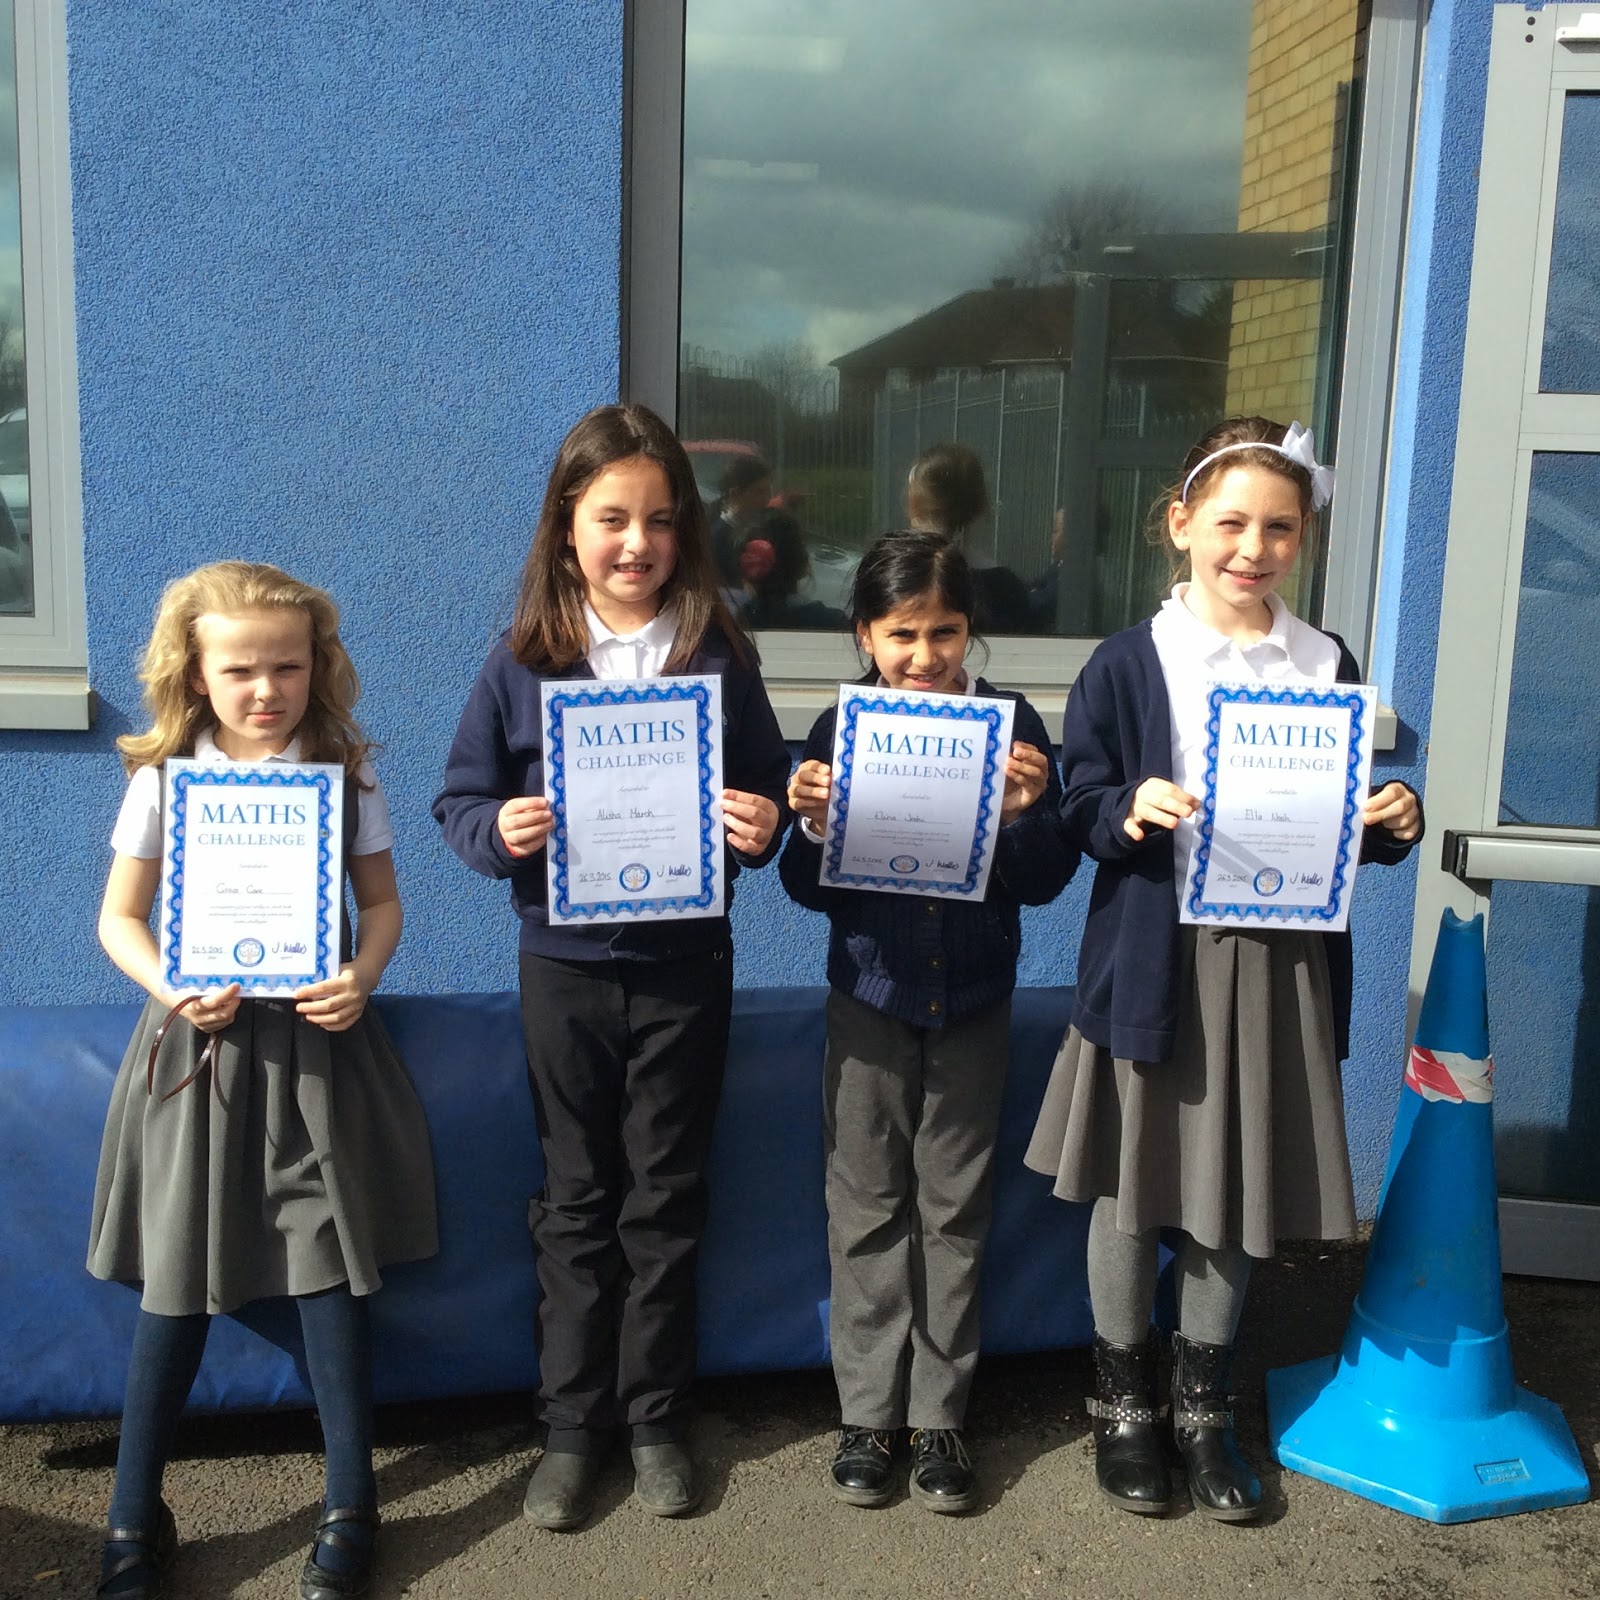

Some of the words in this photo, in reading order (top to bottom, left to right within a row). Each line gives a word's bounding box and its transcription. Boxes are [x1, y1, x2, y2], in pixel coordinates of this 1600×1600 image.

[576, 720, 685, 748] MATHS
[1232, 723, 1337, 749] MATHS
[867, 731, 973, 760] MATHS
[576, 752, 686, 770] CHALLENGE
[864, 762, 970, 780] CHALLENGE
[1230, 755, 1335, 772] CHALLENGE
[199, 803, 306, 825] MATHS
[197, 833, 306, 846] CHALLENGE
